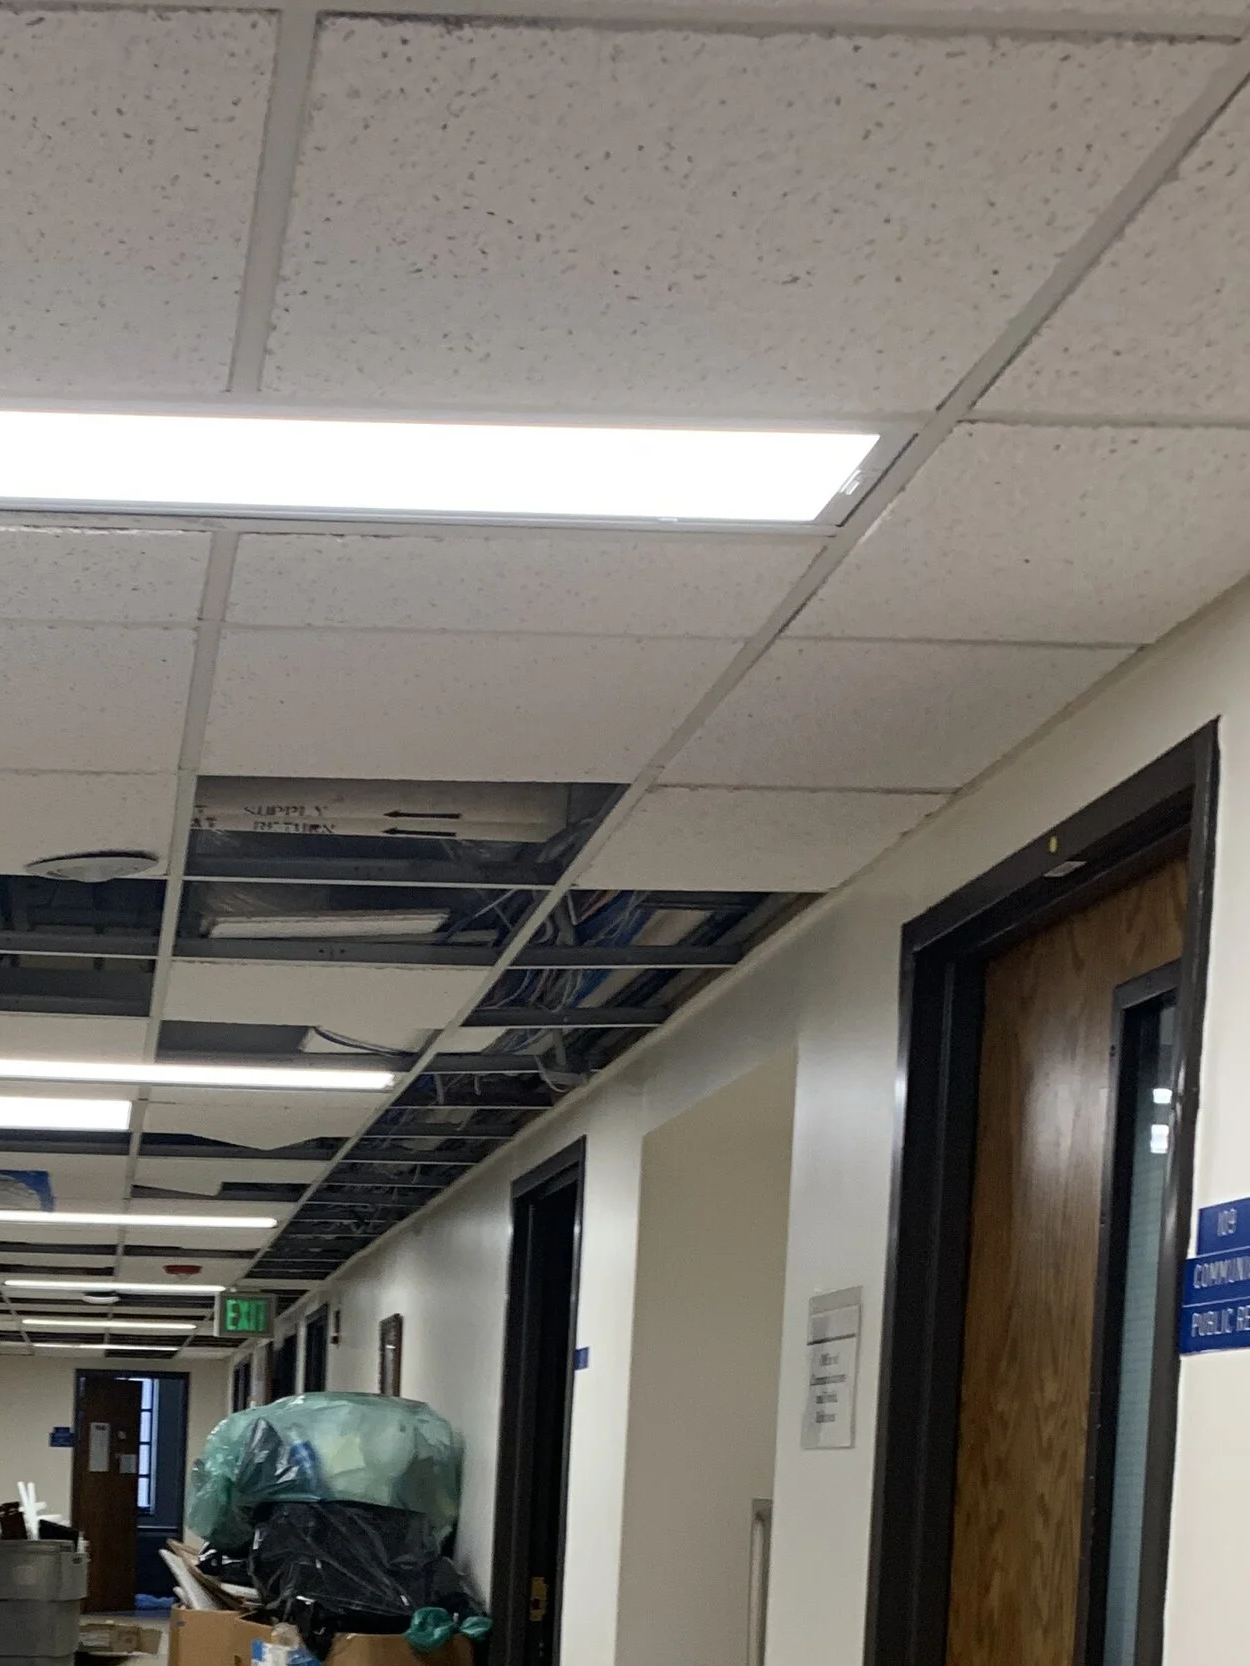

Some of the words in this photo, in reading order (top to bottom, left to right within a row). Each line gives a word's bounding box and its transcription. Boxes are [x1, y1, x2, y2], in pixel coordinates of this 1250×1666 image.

[244, 805, 328, 817] SUPPLY
[253, 820, 336, 834] RETURN
[225, 1299, 266, 1331] EXIT
[1191, 1308, 1233, 1337] PUBLIC
